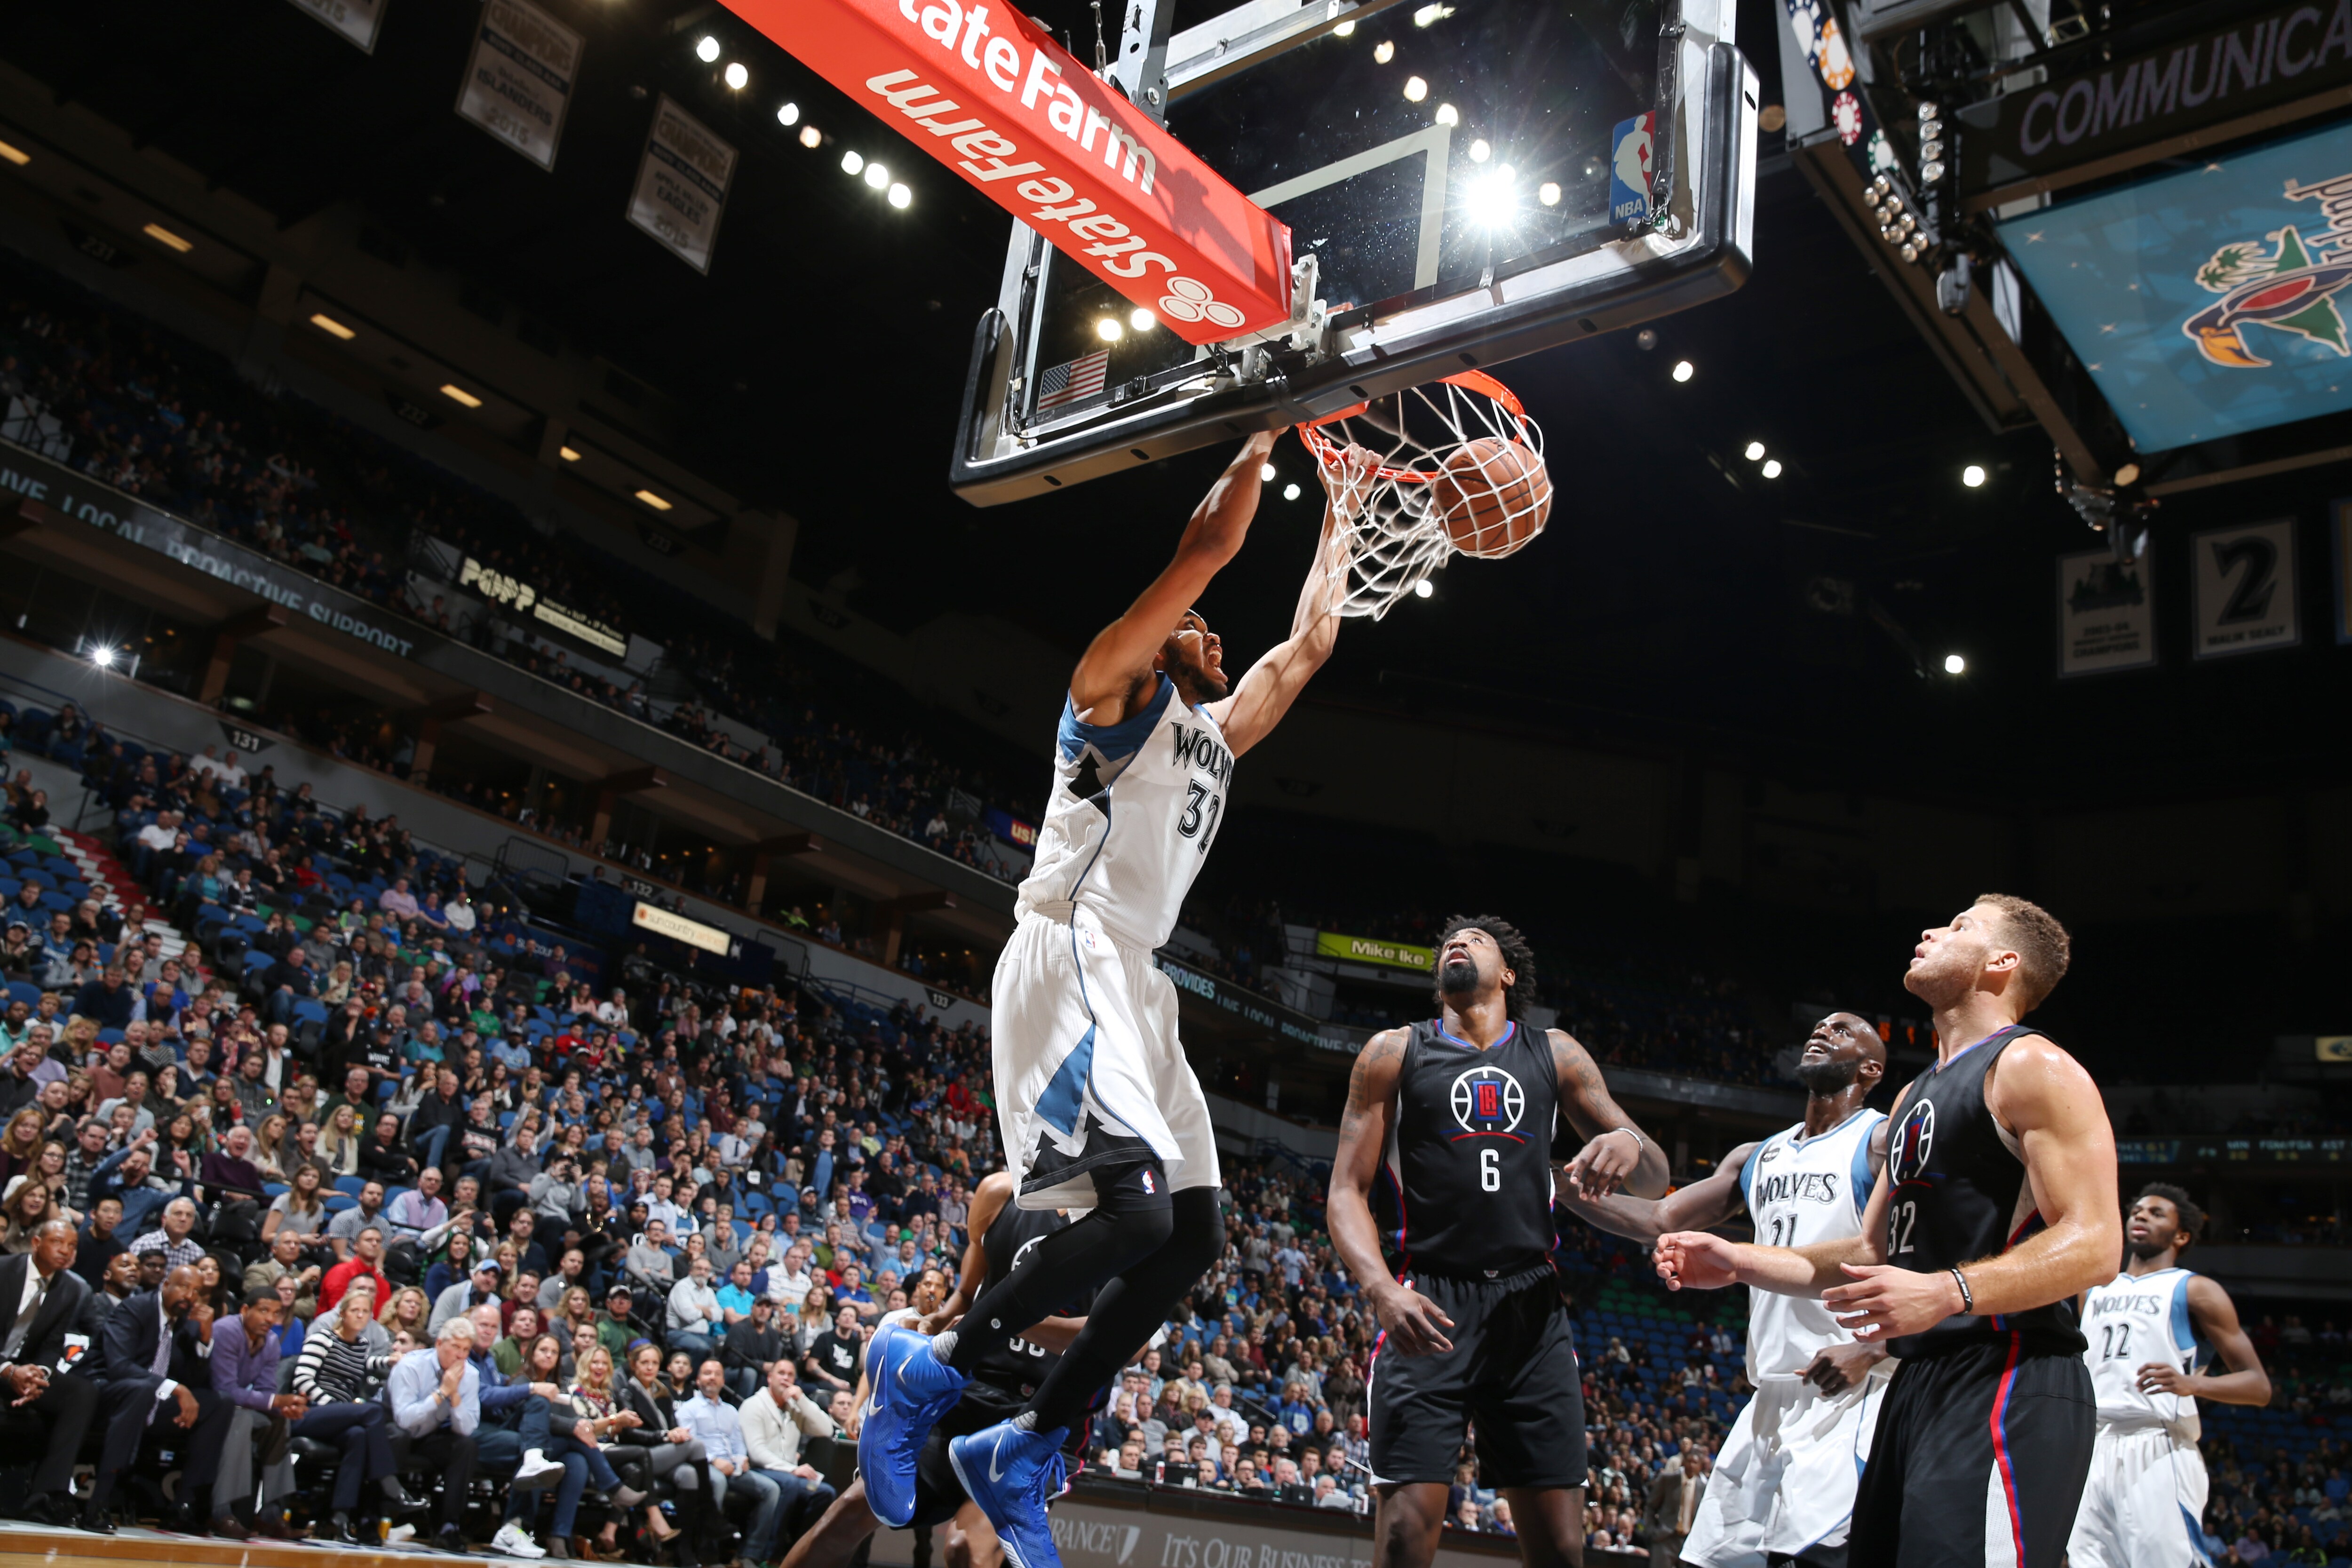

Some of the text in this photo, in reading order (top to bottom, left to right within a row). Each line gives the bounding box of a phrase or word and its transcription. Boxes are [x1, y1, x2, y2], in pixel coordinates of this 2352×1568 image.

[477, 68, 553, 126] ISLANDERS
[2020, 0, 2352, 156] COMMUNICA
[898, 0, 1157, 196] ateFarm
[488, 106, 531, 144] 2015
[657, 186, 700, 226] EAGLES
[1614, 198, 1644, 220] NBA
[654, 215, 690, 249] 2015
[2210, 534, 2279, 626] 2
[232, 729, 260, 752] 131
[1171, 721, 1234, 795] WOLV
[631, 880, 653, 899] 132
[1351, 939, 1426, 965] Mike Ike
[1155, 961, 1216, 1000] PROVIDES
[932, 993, 949, 1008] 133
[1480, 1144, 1501, 1192] 6
[1757, 1172, 1839, 1211] WOLVES
[1769, 1213, 1798, 1248] 21
[1887, 1200, 1916, 1257] 32
[2092, 1295, 2163, 1320] WOLVES
[2101, 1321, 2131, 1362] 22
